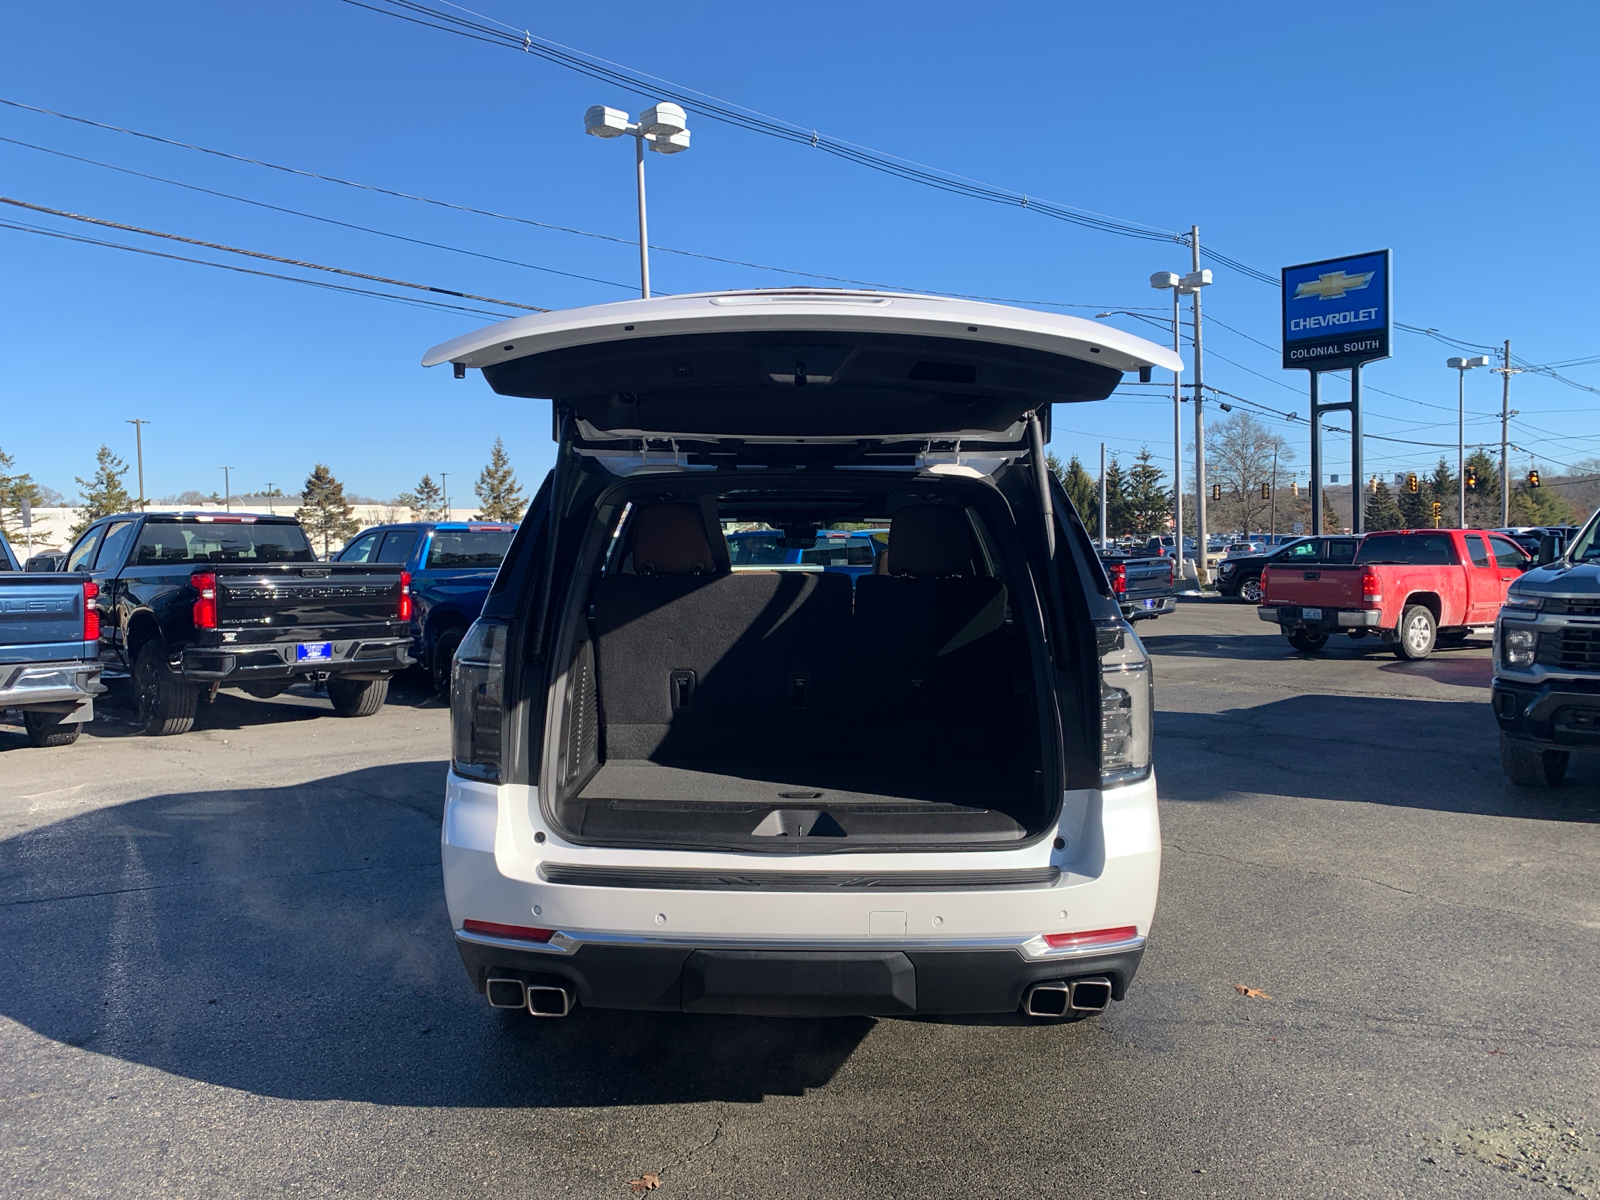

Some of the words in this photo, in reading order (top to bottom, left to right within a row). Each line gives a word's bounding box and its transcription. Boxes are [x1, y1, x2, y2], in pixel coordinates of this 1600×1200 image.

[1290, 307, 1379, 331] CHEVROLET
[1290, 345, 1341, 359] COLONIAL
[1343, 339, 1380, 353] SOUTH
[0, 600, 70, 613] LET
